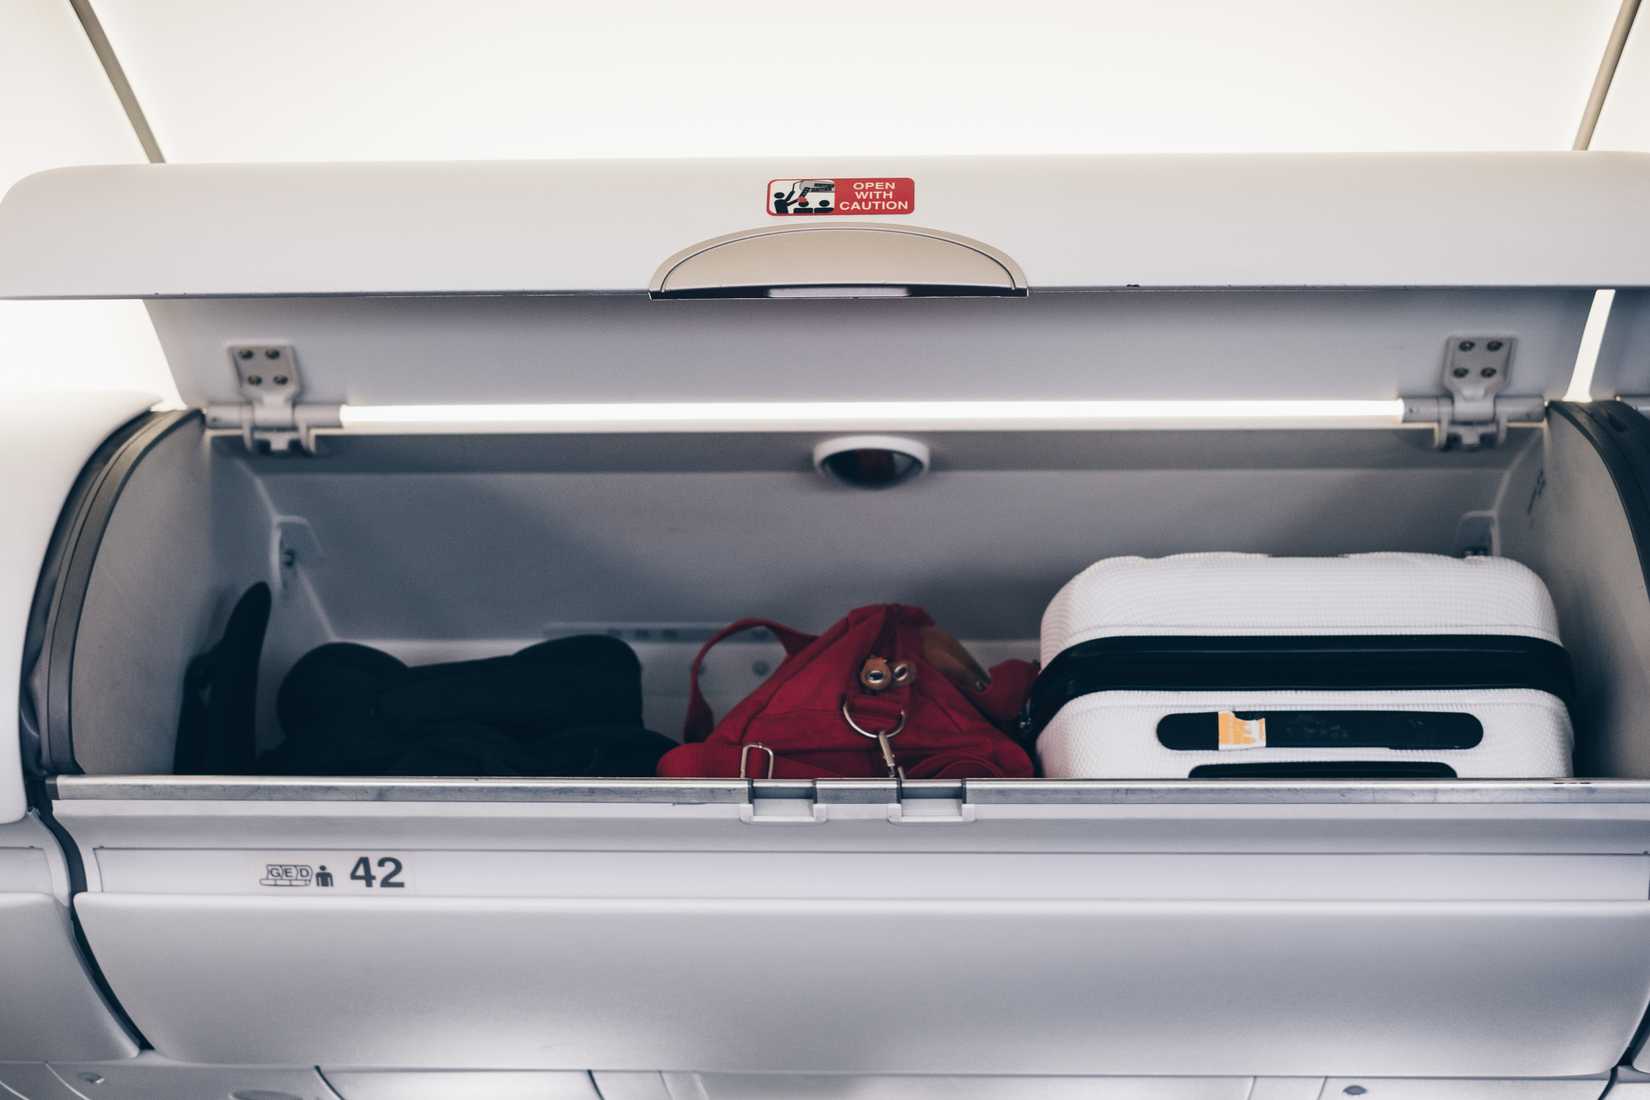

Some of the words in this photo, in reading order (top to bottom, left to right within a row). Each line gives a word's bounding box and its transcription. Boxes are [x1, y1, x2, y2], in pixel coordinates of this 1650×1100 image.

[853, 182, 896, 190] OPEN
[854, 191, 893, 199] WITH
[839, 200, 908, 210] CAUTION
[350, 856, 405, 888] 42
